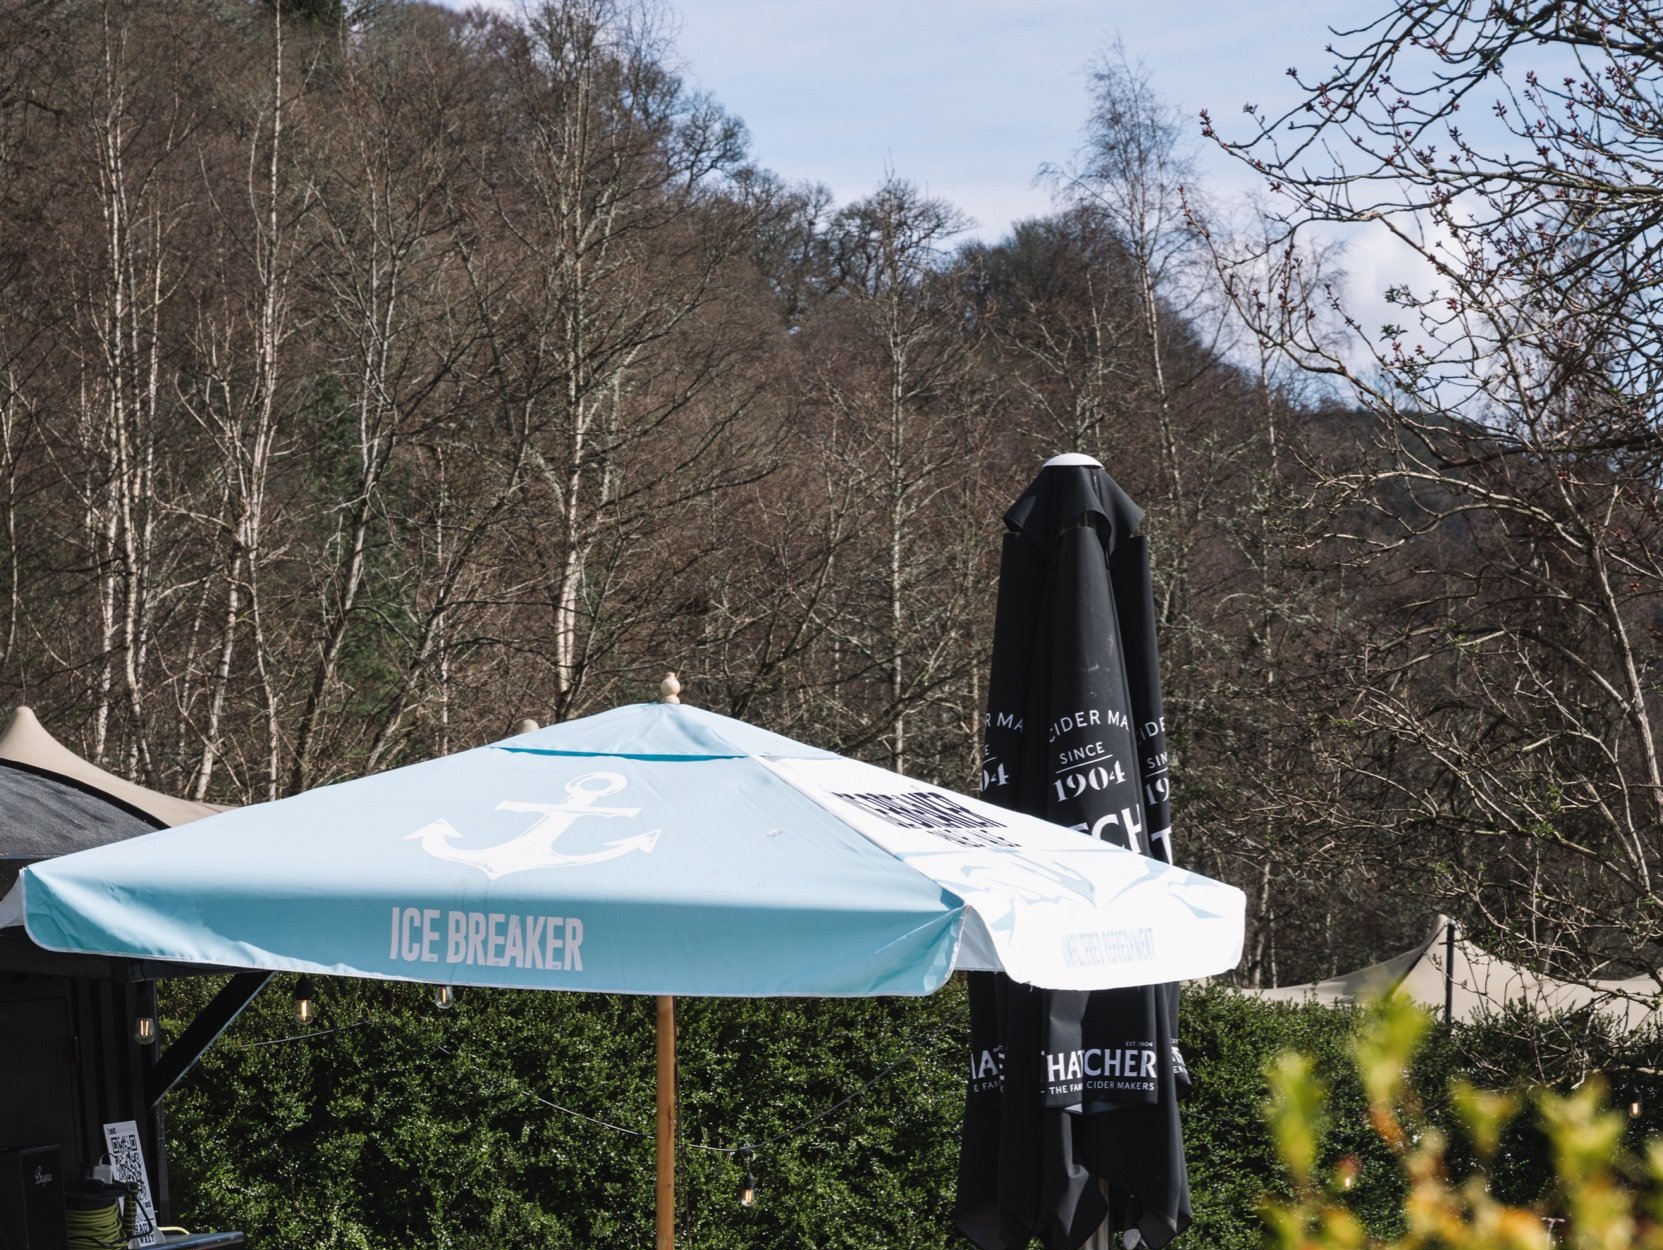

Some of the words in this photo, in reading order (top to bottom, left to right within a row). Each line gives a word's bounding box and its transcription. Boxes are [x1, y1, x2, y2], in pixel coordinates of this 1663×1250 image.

[1059, 742, 1105, 765] SINCE
[1053, 760, 1127, 802] 1904
[389, 907, 441, 963] ICE
[446, 910, 584, 972] BREAKER
[1041, 1048, 1158, 1083] HATCHER
[1048, 1085, 1069, 1095] THE
[1086, 1080, 1115, 1090] CIDER
[1117, 1082, 1155, 1091] MAKERS
